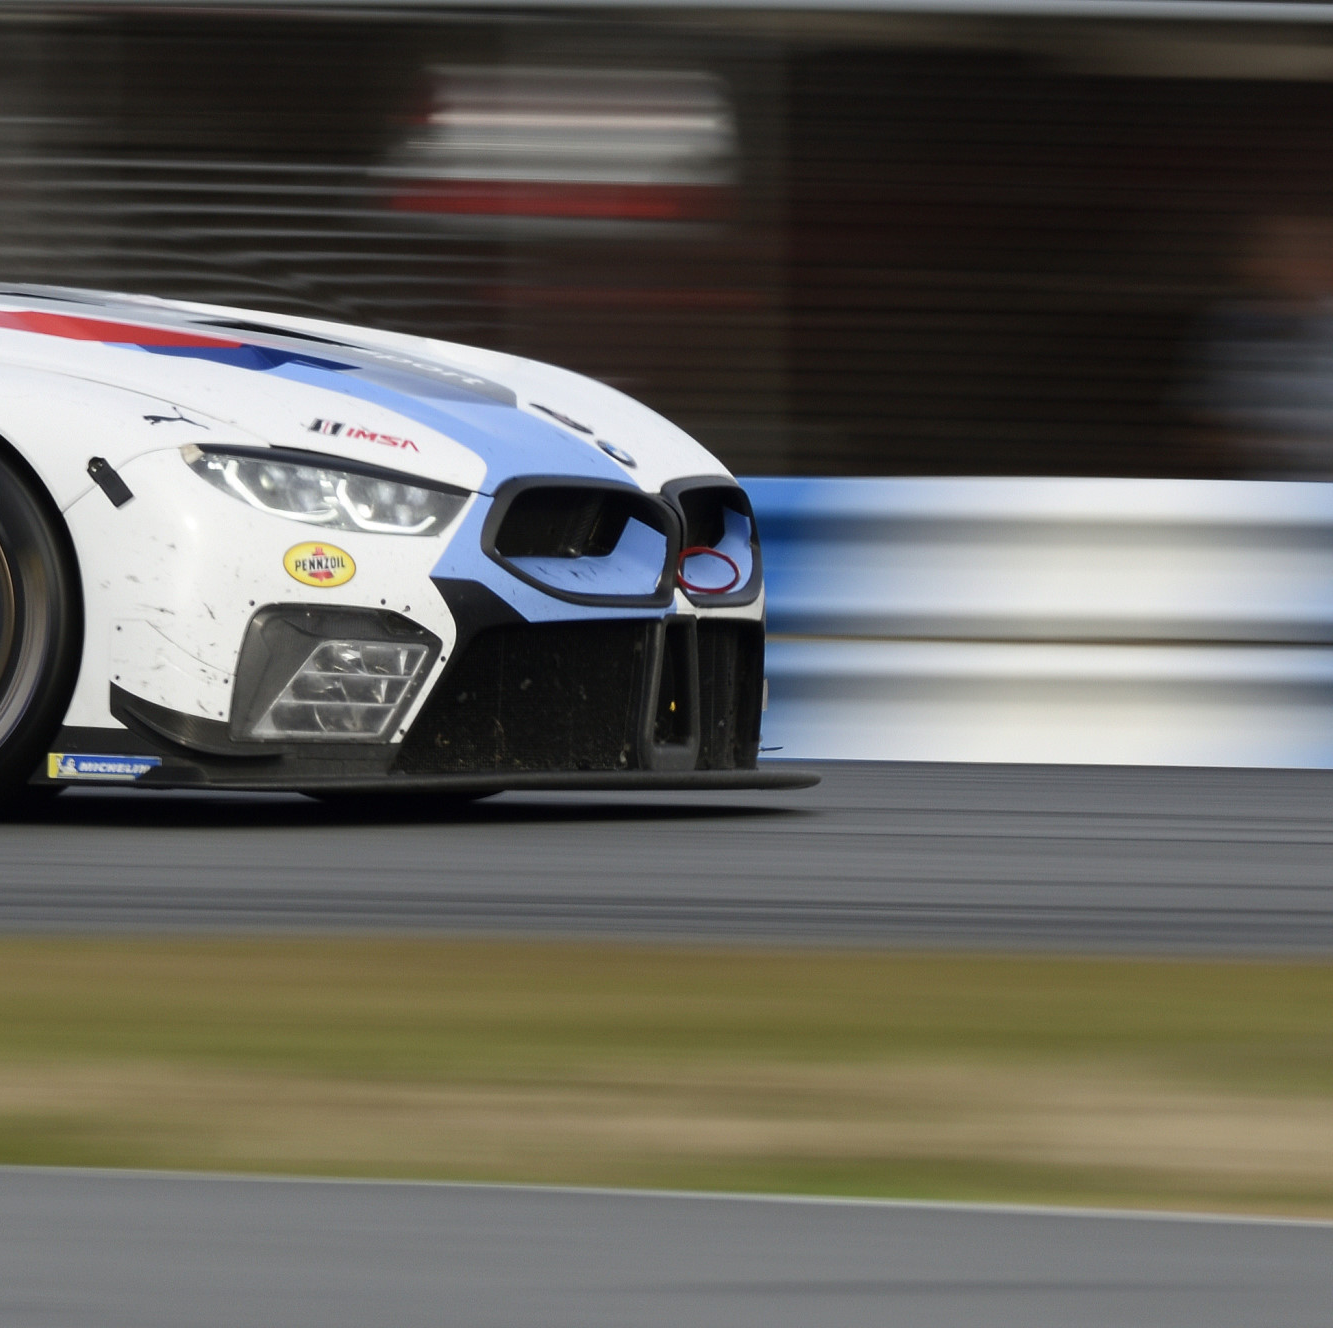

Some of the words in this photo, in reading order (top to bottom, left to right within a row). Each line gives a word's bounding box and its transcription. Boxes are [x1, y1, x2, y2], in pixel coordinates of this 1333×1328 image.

[346, 428, 420, 453] IMSA
[295, 556, 346, 572] PENNZOIL
[79, 762, 152, 774] MICHELIN
